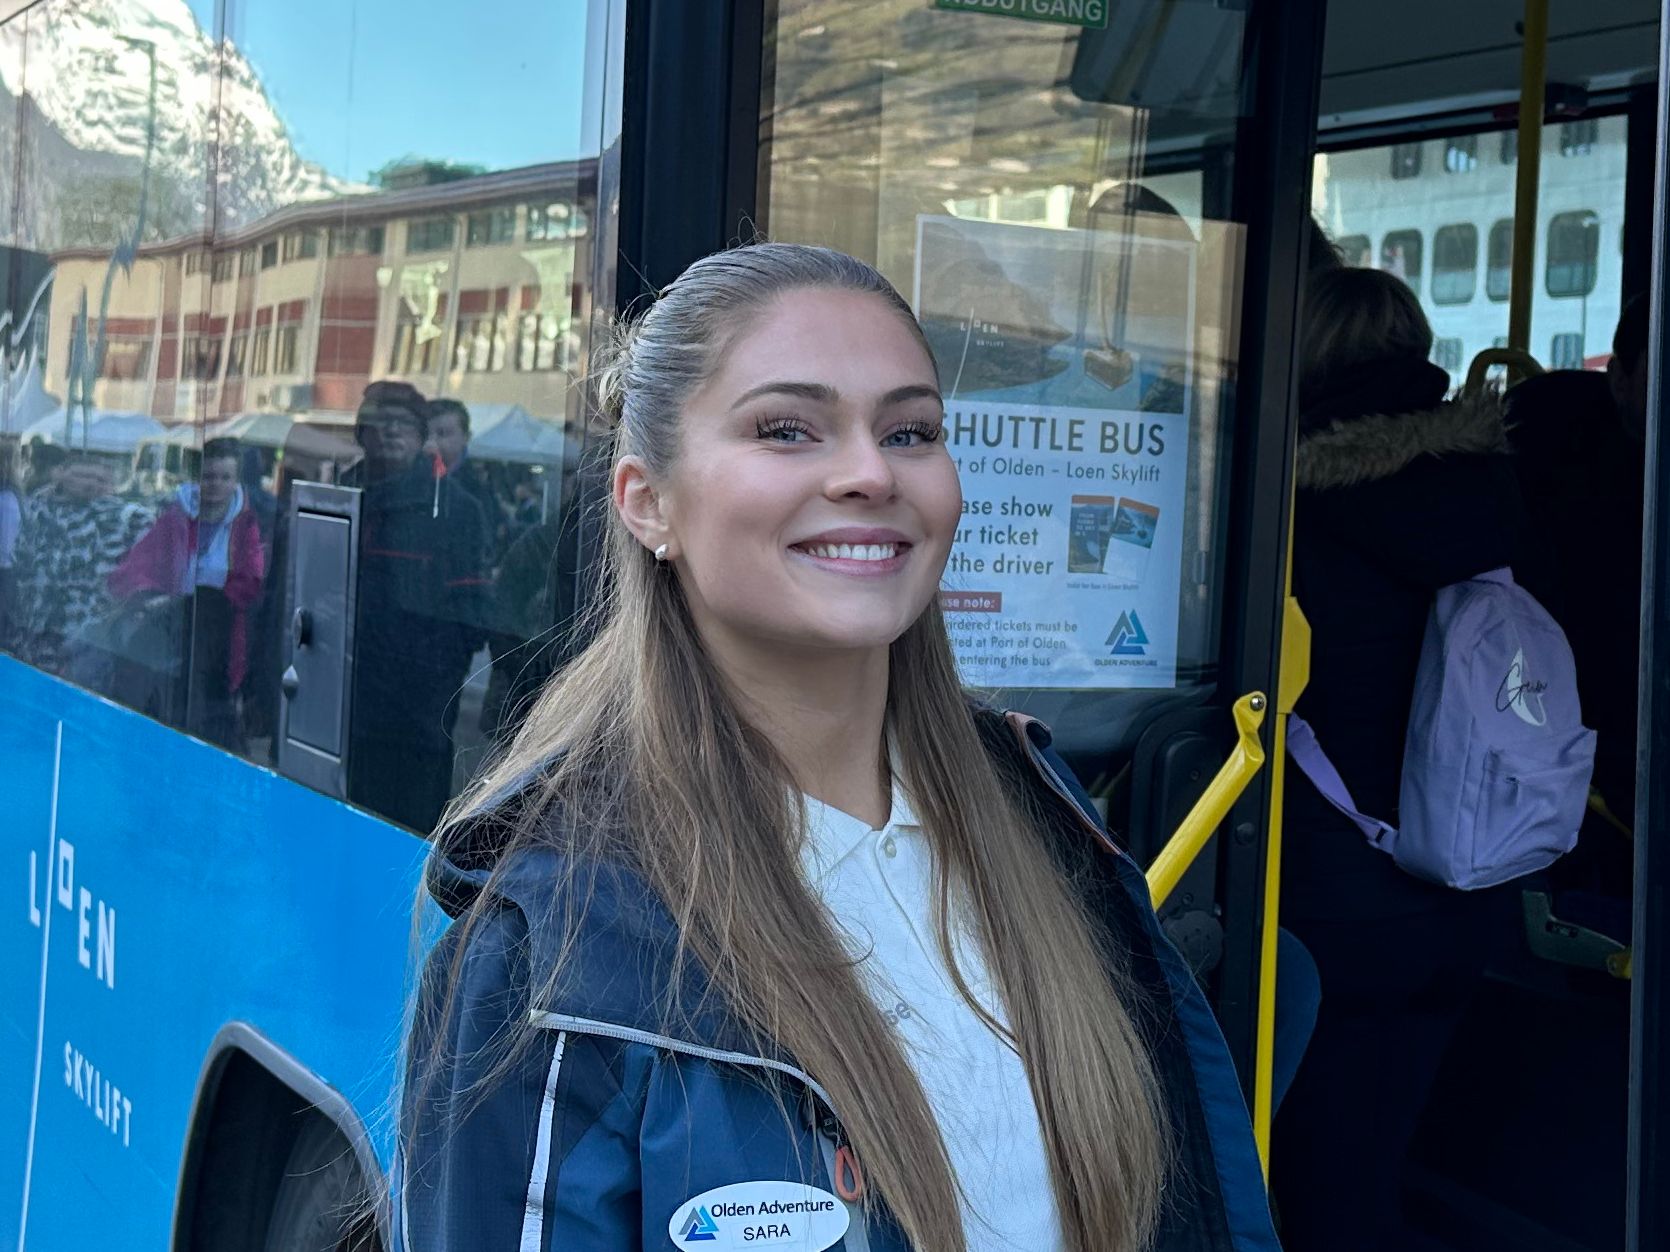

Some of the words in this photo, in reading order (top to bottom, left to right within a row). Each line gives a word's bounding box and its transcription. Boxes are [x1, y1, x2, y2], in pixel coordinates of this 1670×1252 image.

[960, 319, 998, 334] LOEN
[1100, 420, 1165, 456] BUS
[969, 458, 987, 474] of
[993, 458, 1044, 477] Olden
[1067, 462, 1105, 479] Loen
[1112, 464, 1160, 485] Skylift
[961, 500, 993, 515] ase
[1001, 496, 1053, 517] show
[980, 524, 1039, 546] ticket
[951, 552, 985, 573] the
[992, 553, 1054, 575] driver
[963, 597, 995, 608] note:
[995, 620, 1032, 632] tickets
[1035, 622, 1061, 632] must
[1064, 620, 1078, 633] be
[976, 639, 986, 648] at
[991, 637, 1014, 649] Port
[1017, 637, 1029, 648] of
[1032, 637, 1067, 650] Olden
[960, 655, 1007, 668] entering
[1010, 655, 1029, 666] the
[1032, 655, 1051, 666] bus
[29, 837, 115, 990] LOEN
[64, 1040, 132, 1148] SKYLIFT
[711, 1202, 755, 1218] Olden
[758, 1200, 835, 1215] Adventure
[743, 1223, 791, 1241] SARA
